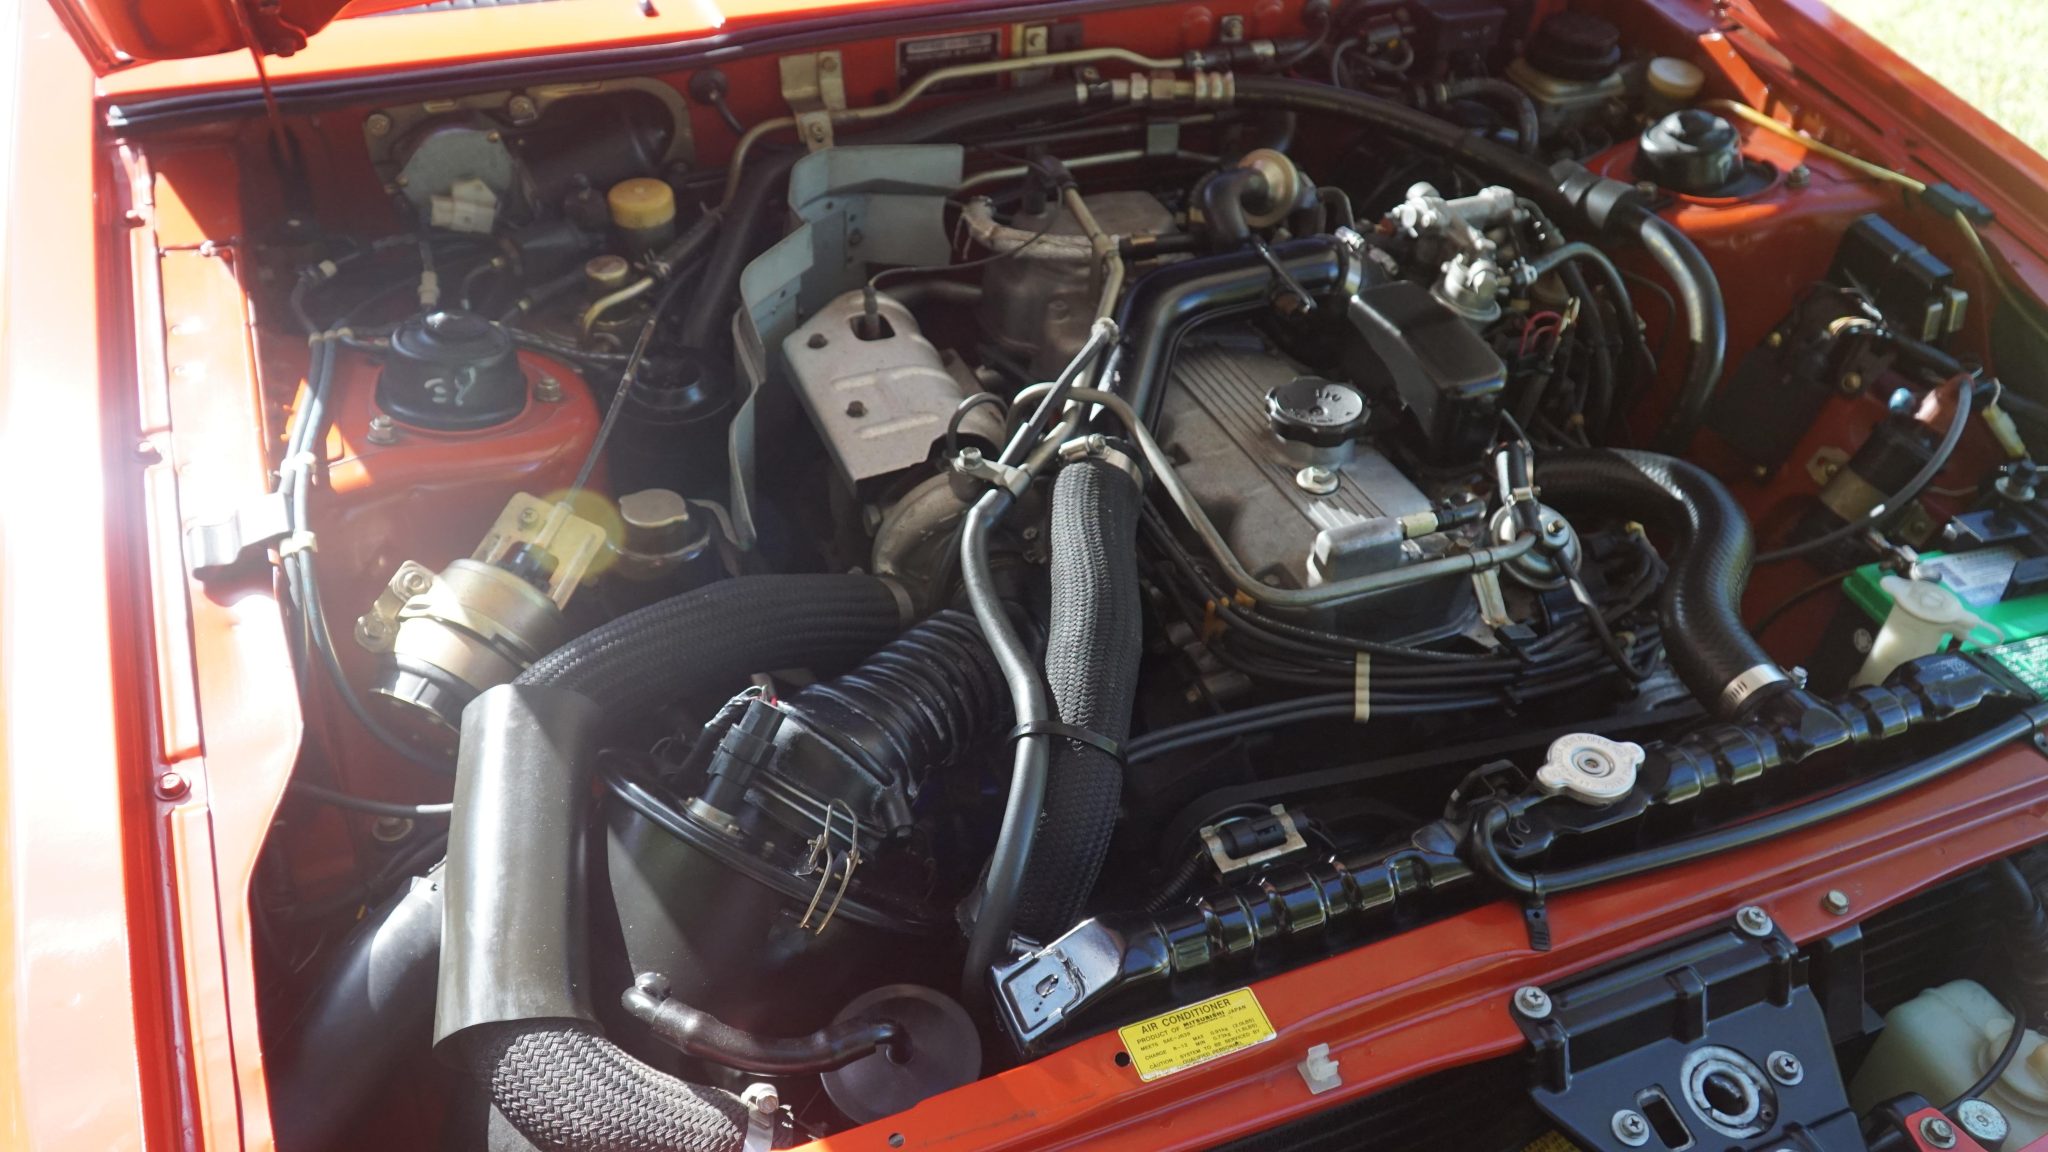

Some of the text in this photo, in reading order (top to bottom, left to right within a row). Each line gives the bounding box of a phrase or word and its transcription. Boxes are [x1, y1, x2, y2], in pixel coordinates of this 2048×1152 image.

[1136, 1030, 1168, 1044] PRODUCT
[1183, 1010, 1225, 1027] MITSUBISHI
[1228, 1004, 1246, 1014] JAPAN
[1141, 1022, 1158, 1034] AIR
[1162, 998, 1231, 1027] CONDITIONER
[1144, 1049, 1167, 1060] CHARGE
[1149, 1058, 1173, 1069] CAUTION
[1179, 1049, 1201, 1059] SYSTEM
